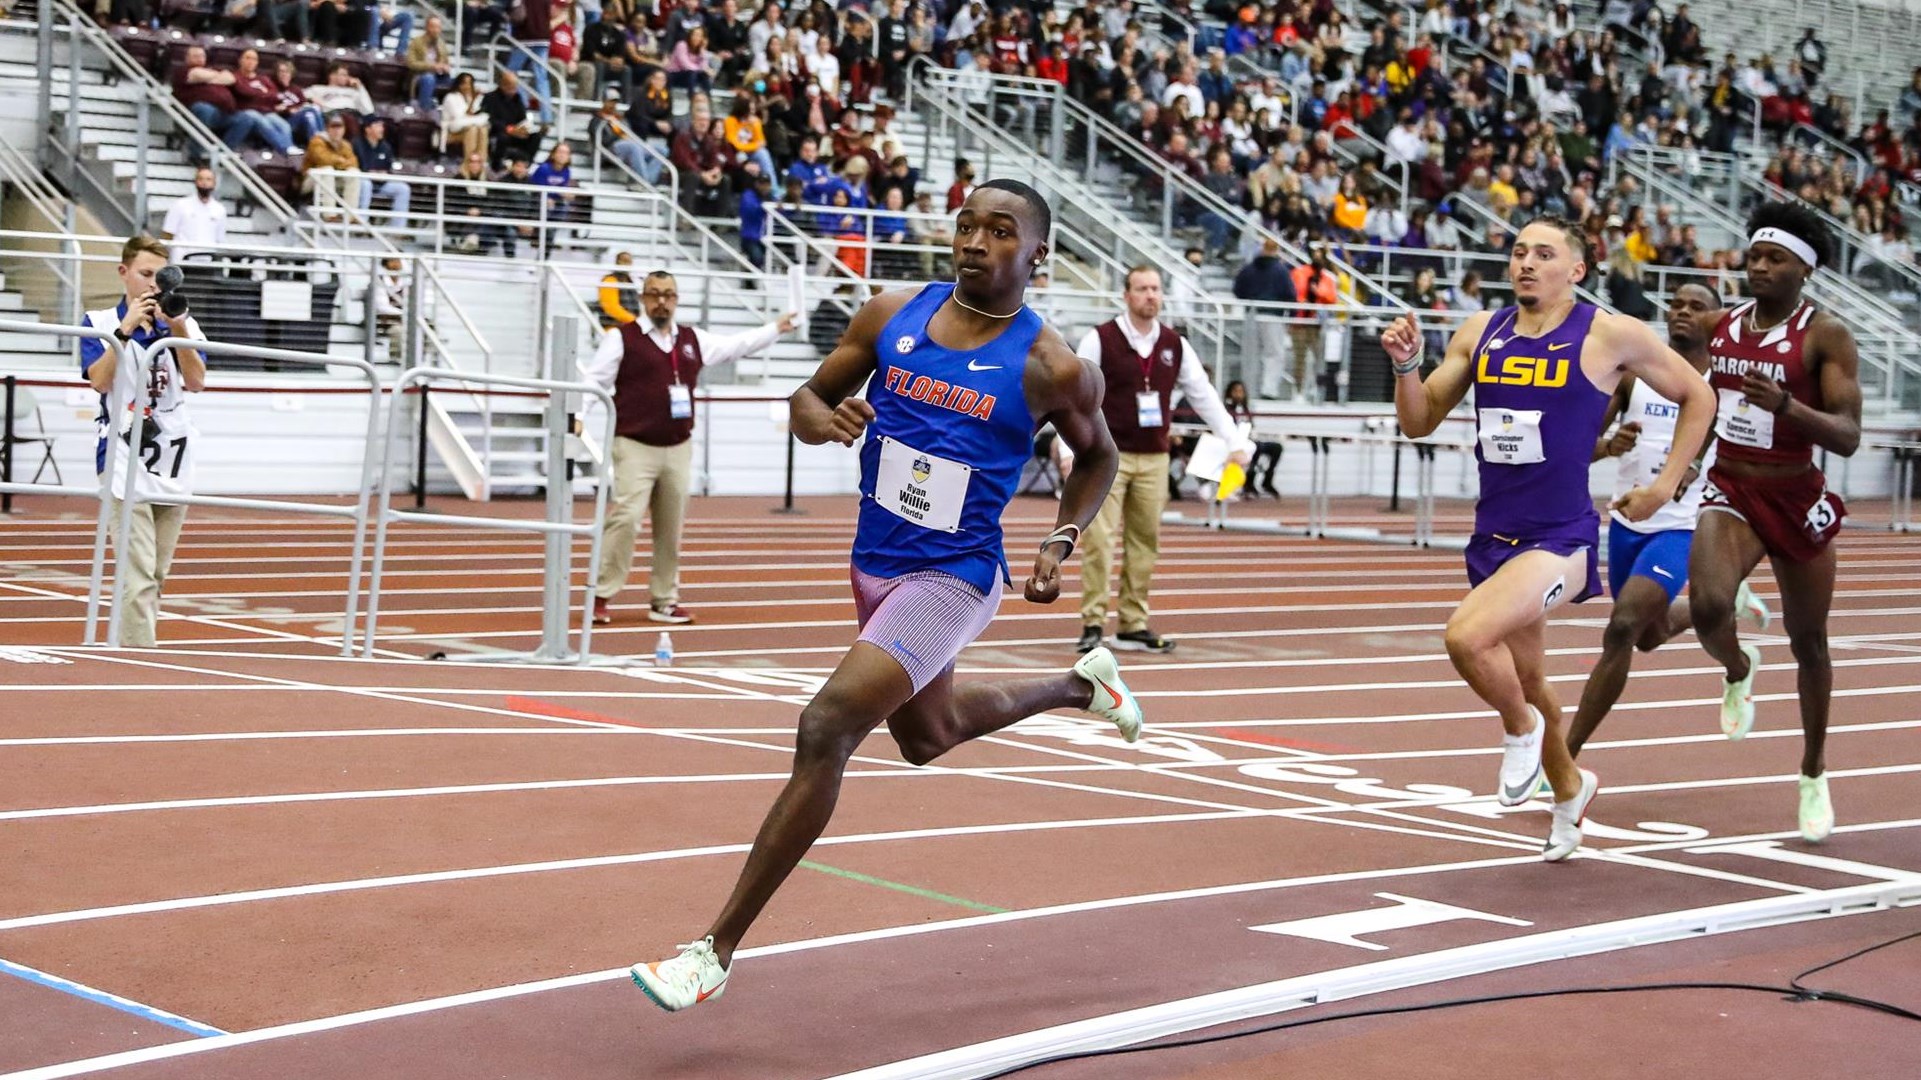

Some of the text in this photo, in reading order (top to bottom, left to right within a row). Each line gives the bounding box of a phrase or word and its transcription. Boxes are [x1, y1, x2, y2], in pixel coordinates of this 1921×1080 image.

[1477, 354, 1570, 388] LSU
[885, 365, 997, 421] FLORIDA
[139, 436, 187, 478] 27
[899, 489, 931, 512] Willie
[907, 483, 926, 497] Ryan
[900, 504, 923, 520] Florida
[1248, 892, 1535, 951] 1
